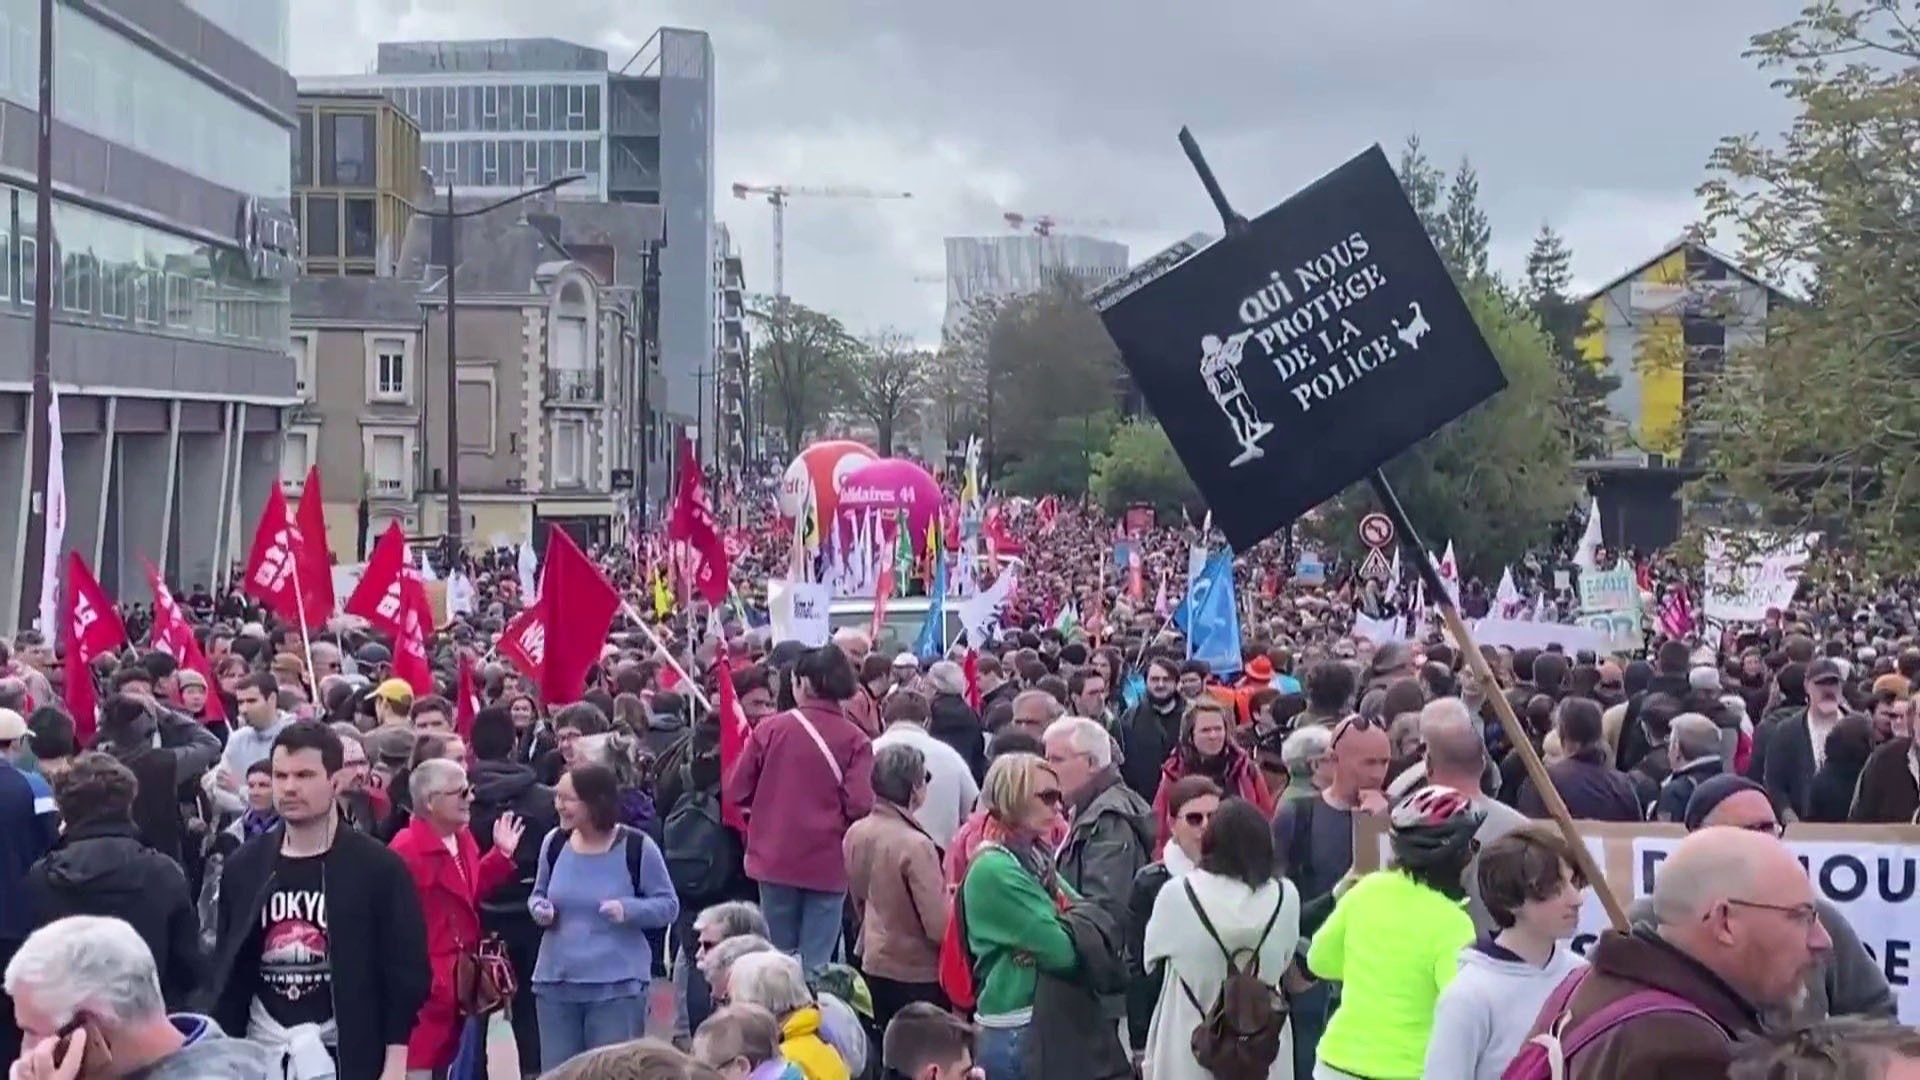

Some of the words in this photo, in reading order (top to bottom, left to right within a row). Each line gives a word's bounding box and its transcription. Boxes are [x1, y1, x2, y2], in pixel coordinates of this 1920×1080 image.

[1294, 232, 1370, 292] NOUS
[1273, 343, 1317, 383] DE
[1317, 318, 1362, 355] LA
[1798, 854, 1917, 904] OU
